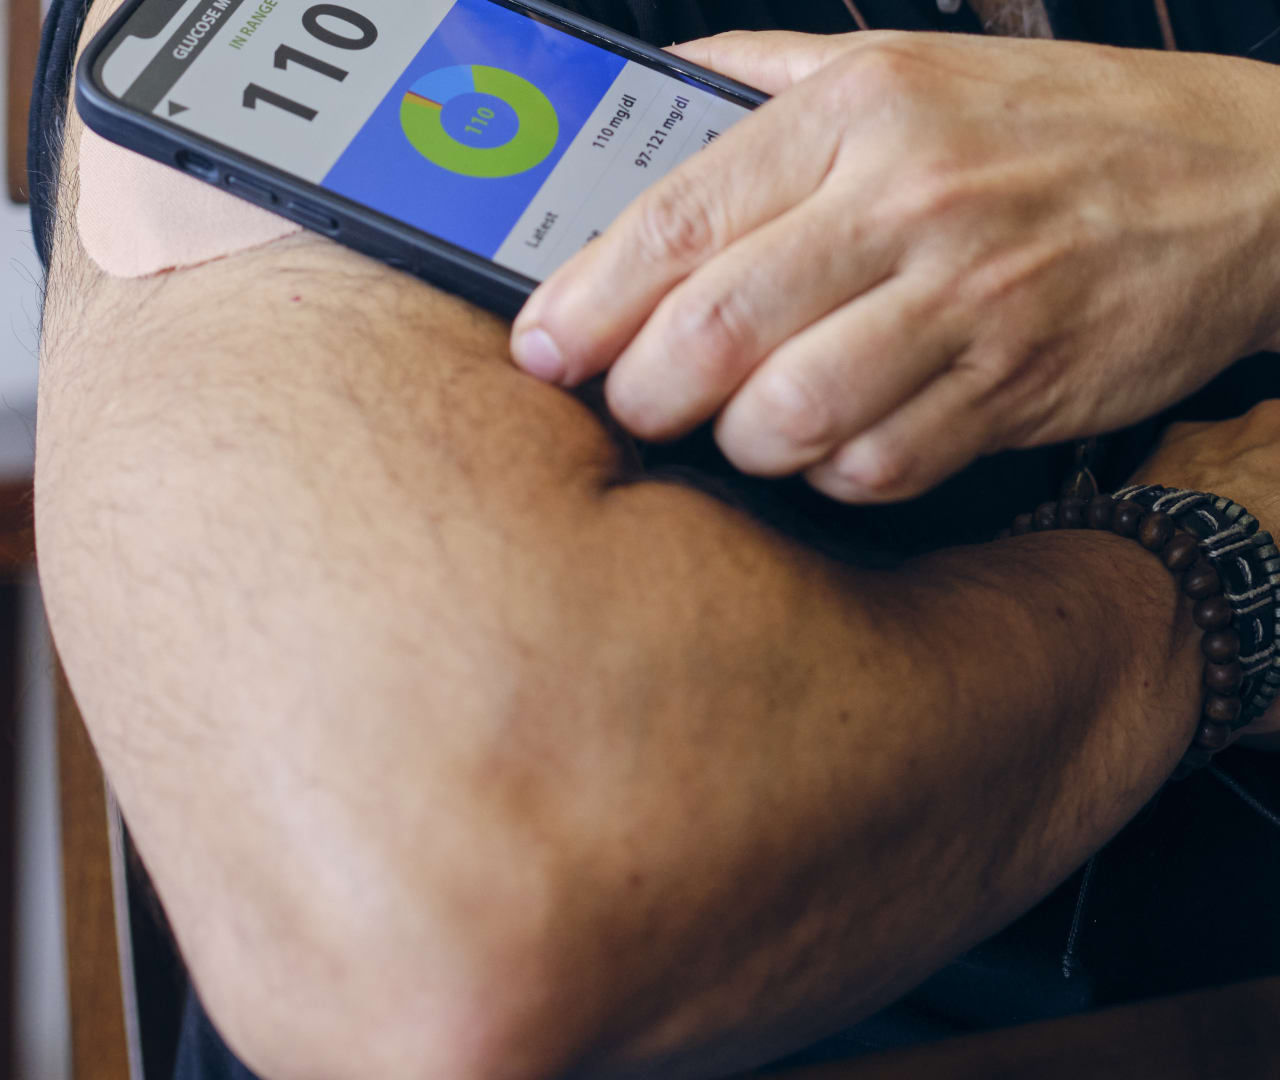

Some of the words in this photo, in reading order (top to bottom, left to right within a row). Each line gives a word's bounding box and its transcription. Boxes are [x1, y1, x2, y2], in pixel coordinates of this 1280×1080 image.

[172, 8, 221, 60] GLUCOSE
[228, 35, 249, 50] IN
[242, 3, 379, 122] 110
[464, 106, 496, 136] 110
[591, 127, 615, 149] 110
[609, 94, 637, 129] mg/dl
[634, 129, 668, 168] 97-121
[662, 95, 690, 130] mg/dl
[524, 211, 559, 249] Latest
